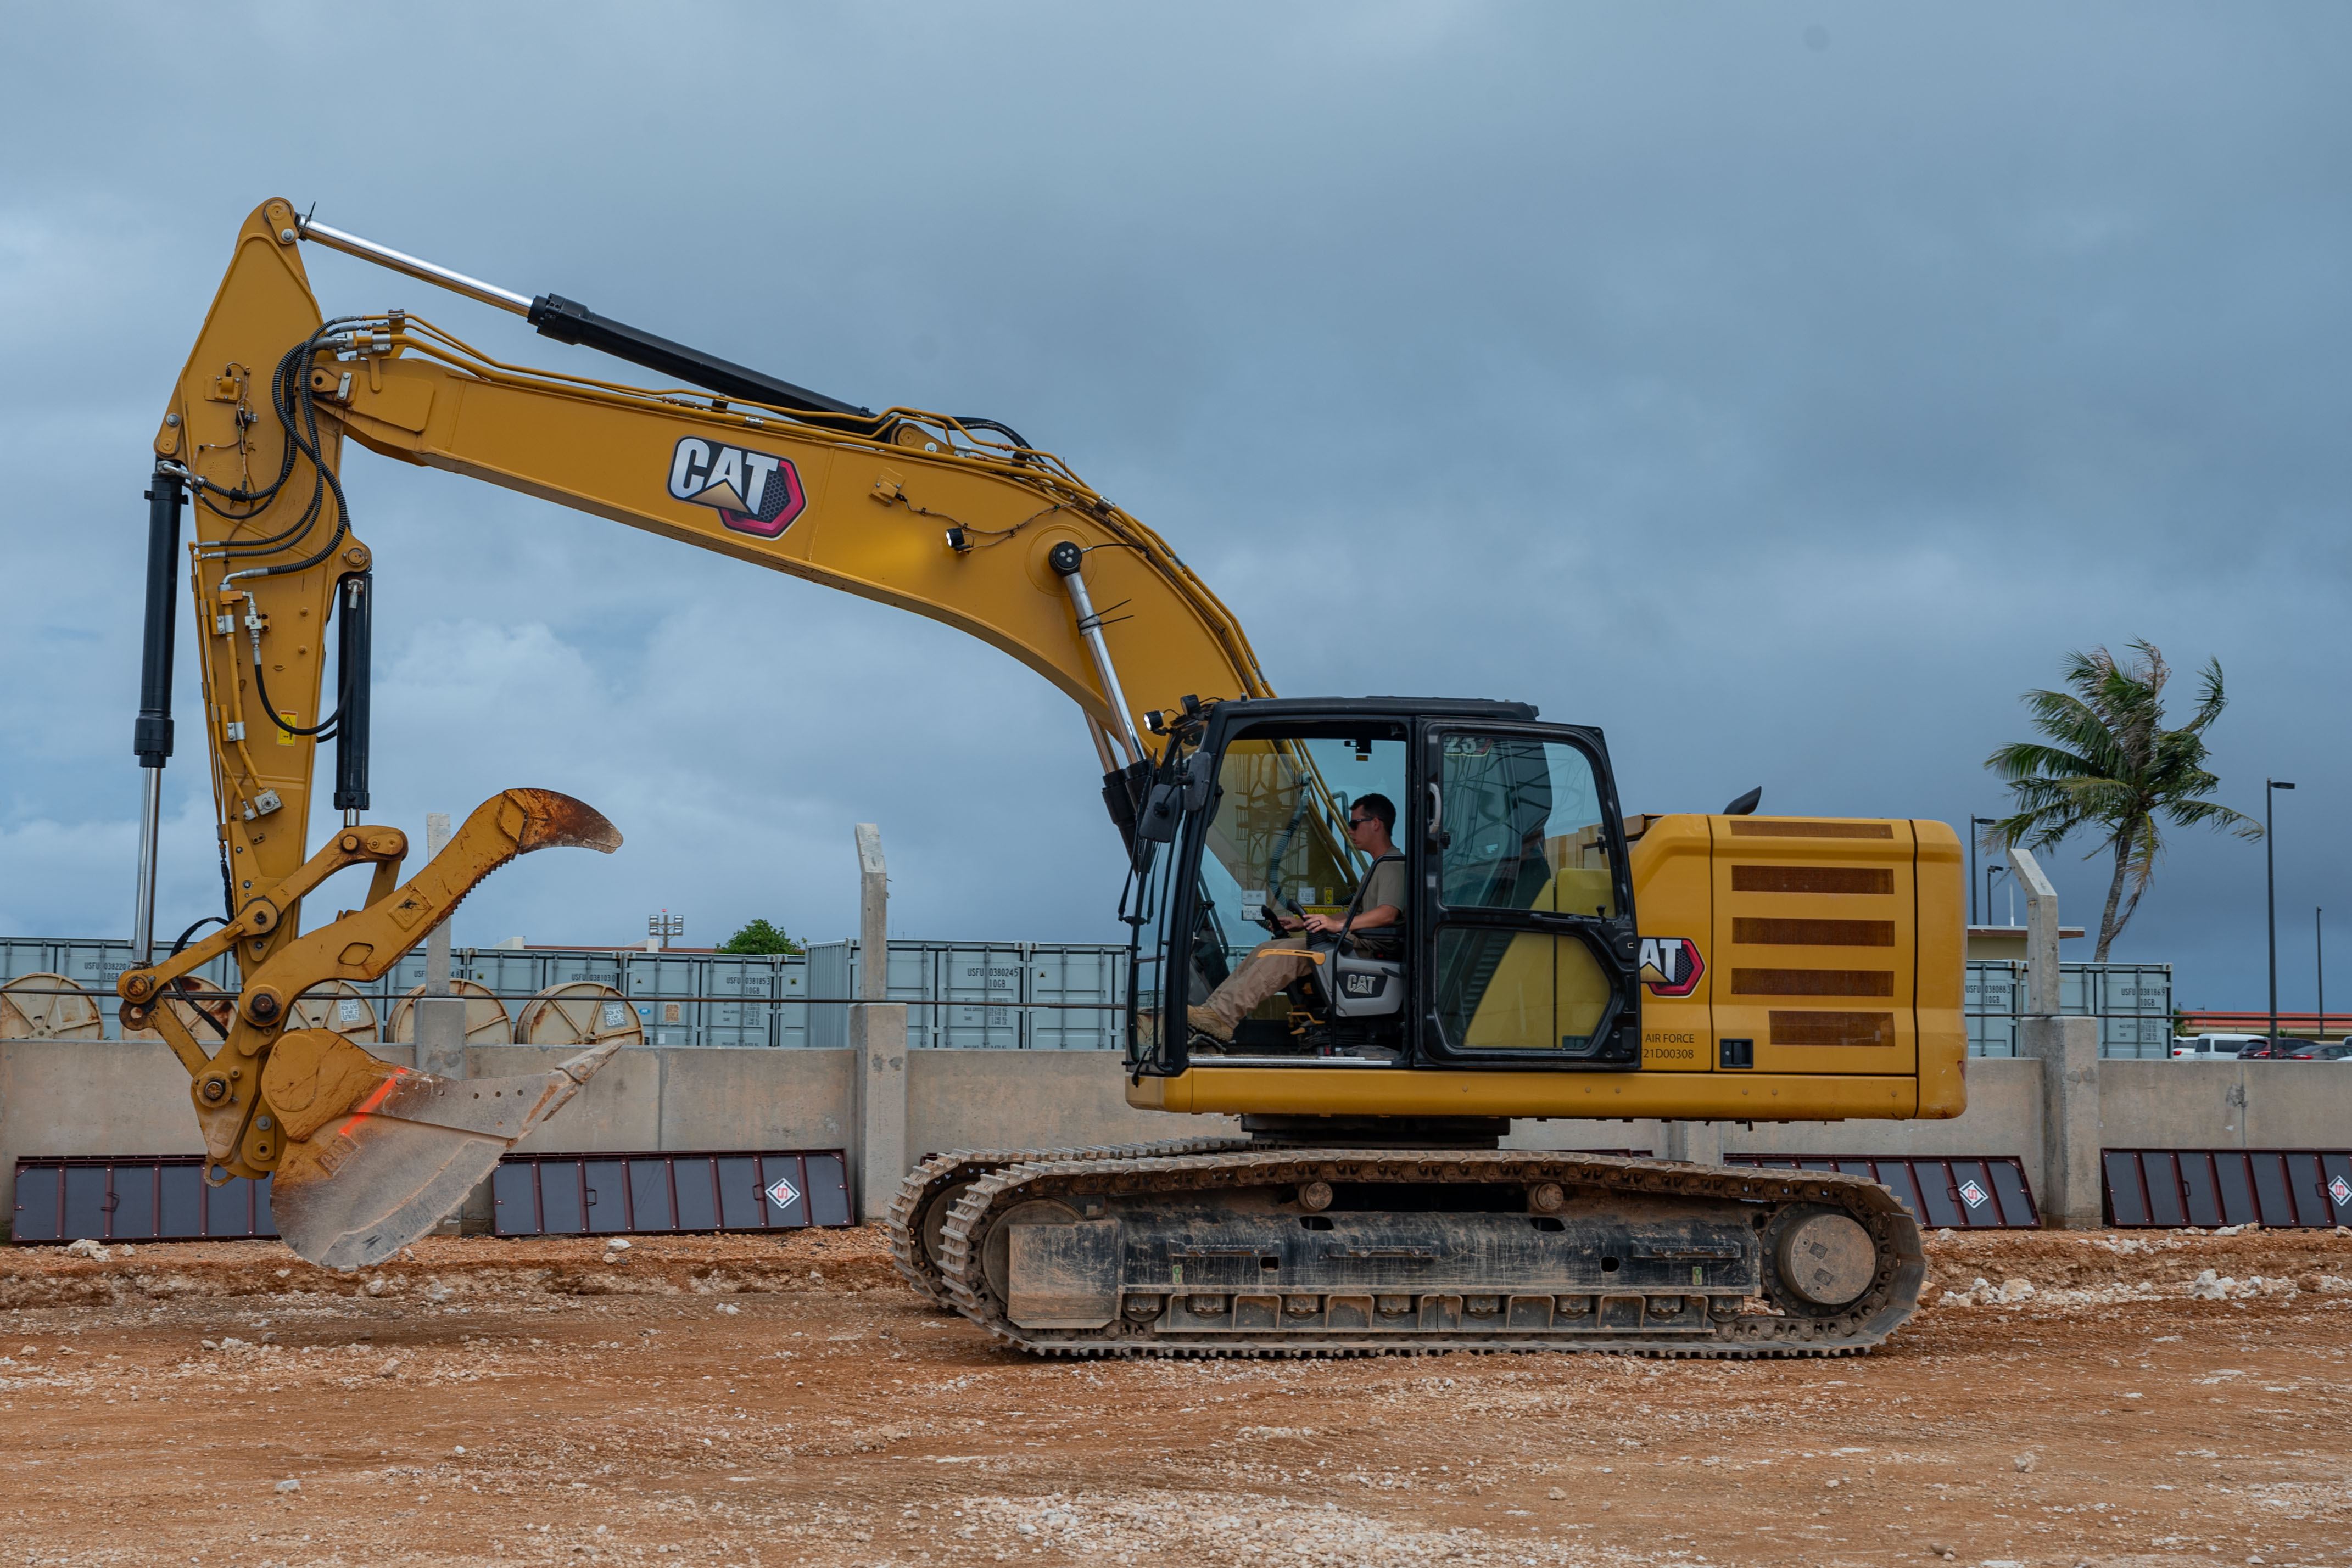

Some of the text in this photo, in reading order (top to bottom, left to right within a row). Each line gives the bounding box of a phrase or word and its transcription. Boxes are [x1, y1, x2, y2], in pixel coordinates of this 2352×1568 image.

[670, 439, 779, 515] CAT
[1639, 939, 1681, 983] AT
[967, 968, 1019, 977] USFU 0380245
[990, 979, 1006, 988] 10GB
[1347, 973, 1376, 994] CAT
[2121, 988, 2136, 996] USFU
[1645, 1034, 1694, 1043] AIR FORCE
[1642, 1049, 1694, 1059] 21D00308
